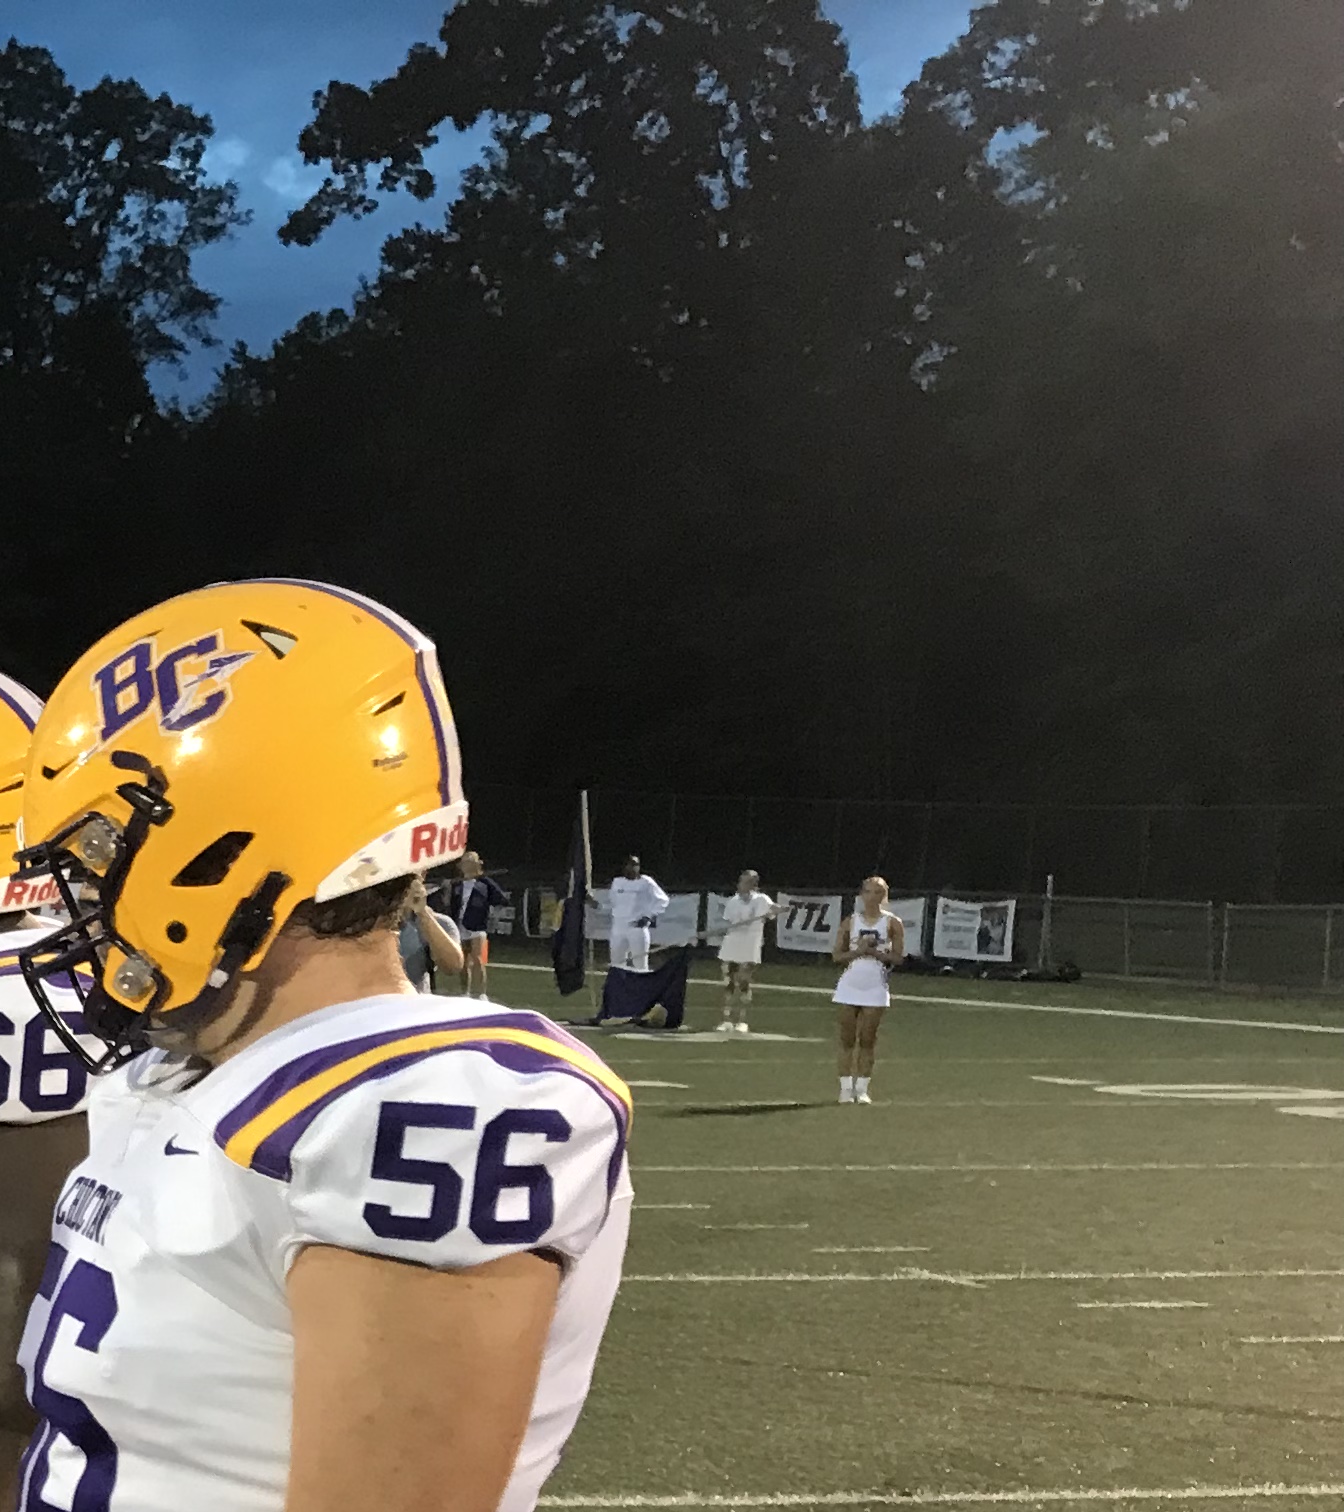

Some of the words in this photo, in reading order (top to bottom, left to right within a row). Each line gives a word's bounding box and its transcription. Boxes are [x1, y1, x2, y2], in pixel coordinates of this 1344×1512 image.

[91, 628, 238, 743] BC
[784, 899, 831, 933] TTL
[362, 1101, 573, 1245] 56
